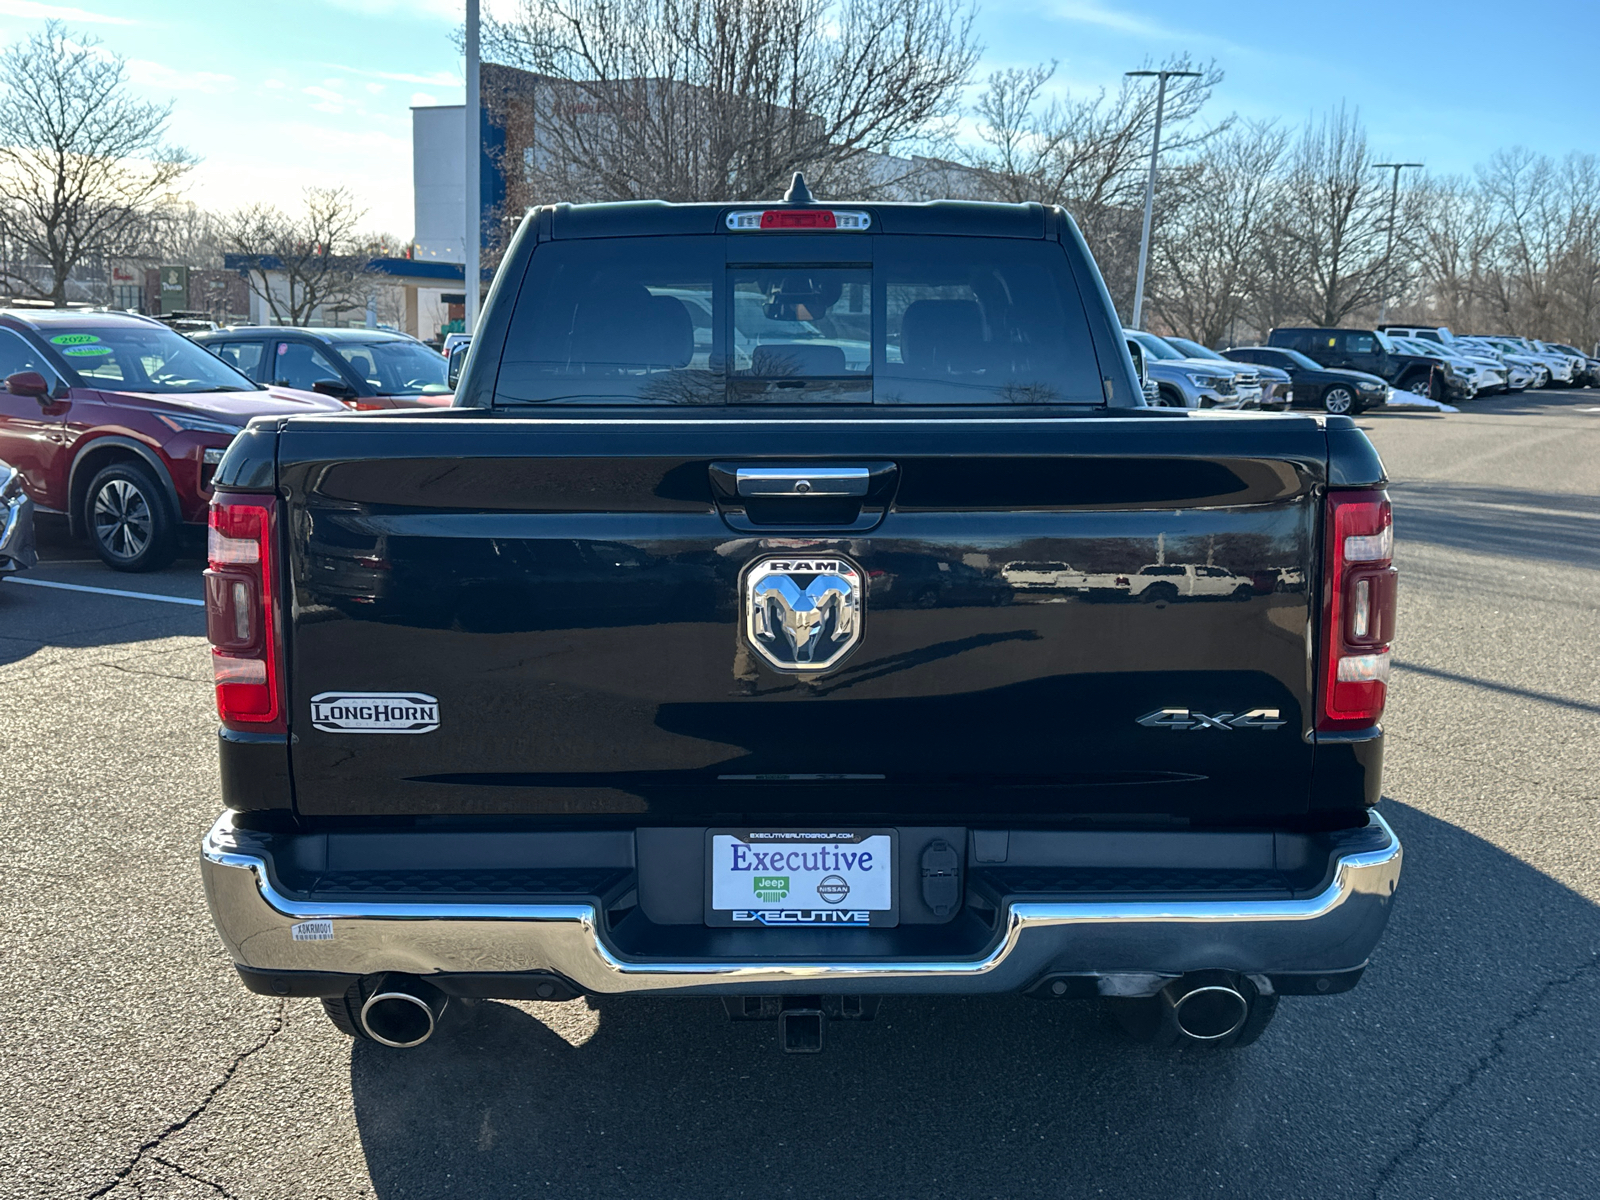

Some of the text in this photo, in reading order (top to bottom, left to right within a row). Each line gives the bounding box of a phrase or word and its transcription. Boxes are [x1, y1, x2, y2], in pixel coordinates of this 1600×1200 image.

[60, 336, 92, 344] 2022
[770, 562, 837, 571] RAM
[730, 844, 873, 871] Executive
[758, 878, 785, 888] Jeep
[732, 910, 870, 924] EXECUTIVE
